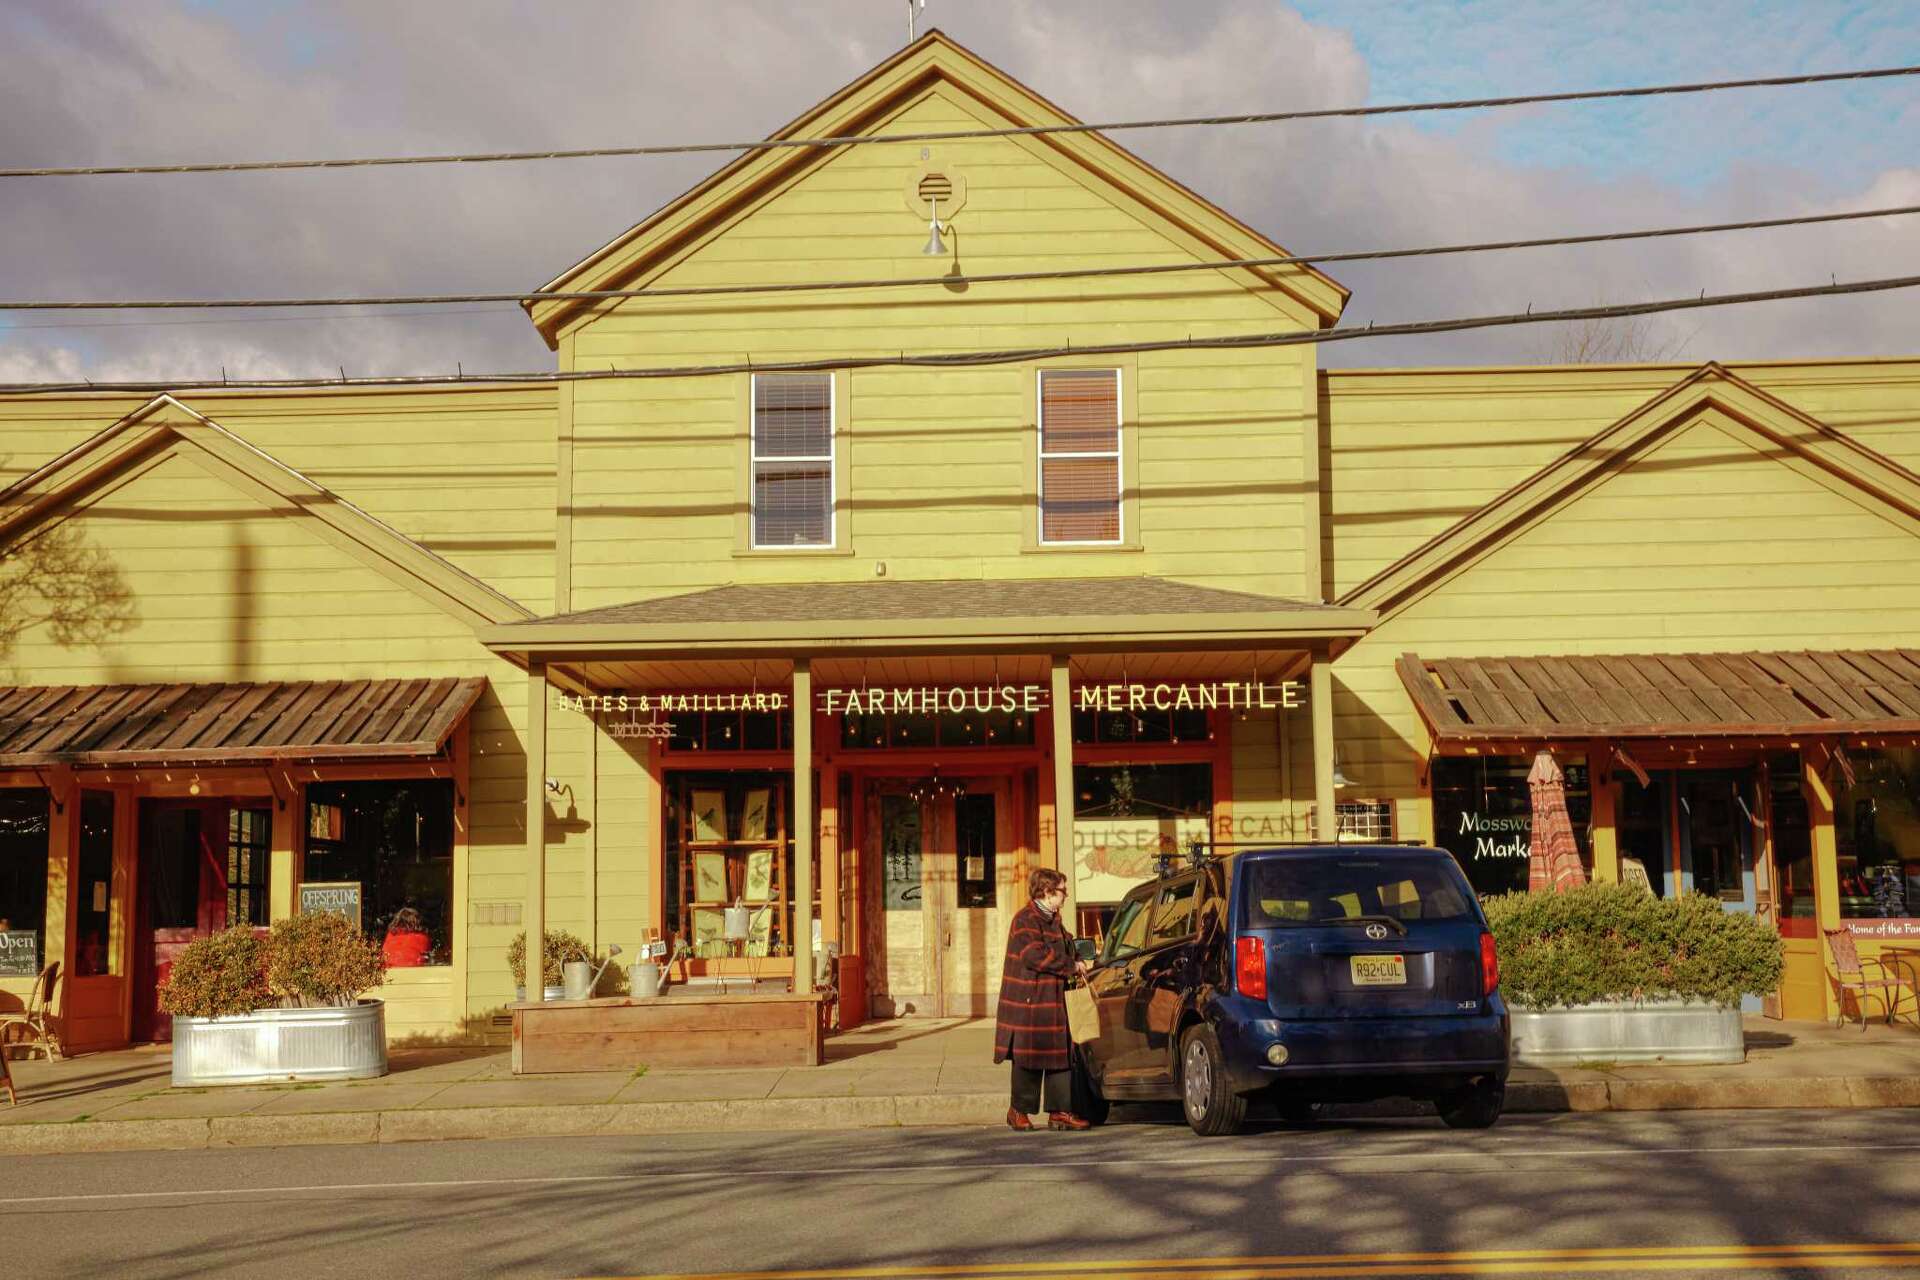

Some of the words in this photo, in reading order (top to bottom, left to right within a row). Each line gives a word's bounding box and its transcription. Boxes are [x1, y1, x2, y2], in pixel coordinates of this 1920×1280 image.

[559, 695, 628, 712] BATES
[640, 696, 650, 712] &
[661, 693, 782, 712] MAILLIARD
[827, 686, 1040, 715] FARMHOUSE
[1081, 682, 1298, 712] MERCANTILE
[614, 722, 671, 738] MOSS
[1876, 921, 1887, 937] of
[1888, 922, 1902, 935] the
[0, 932, 34, 954] Open
